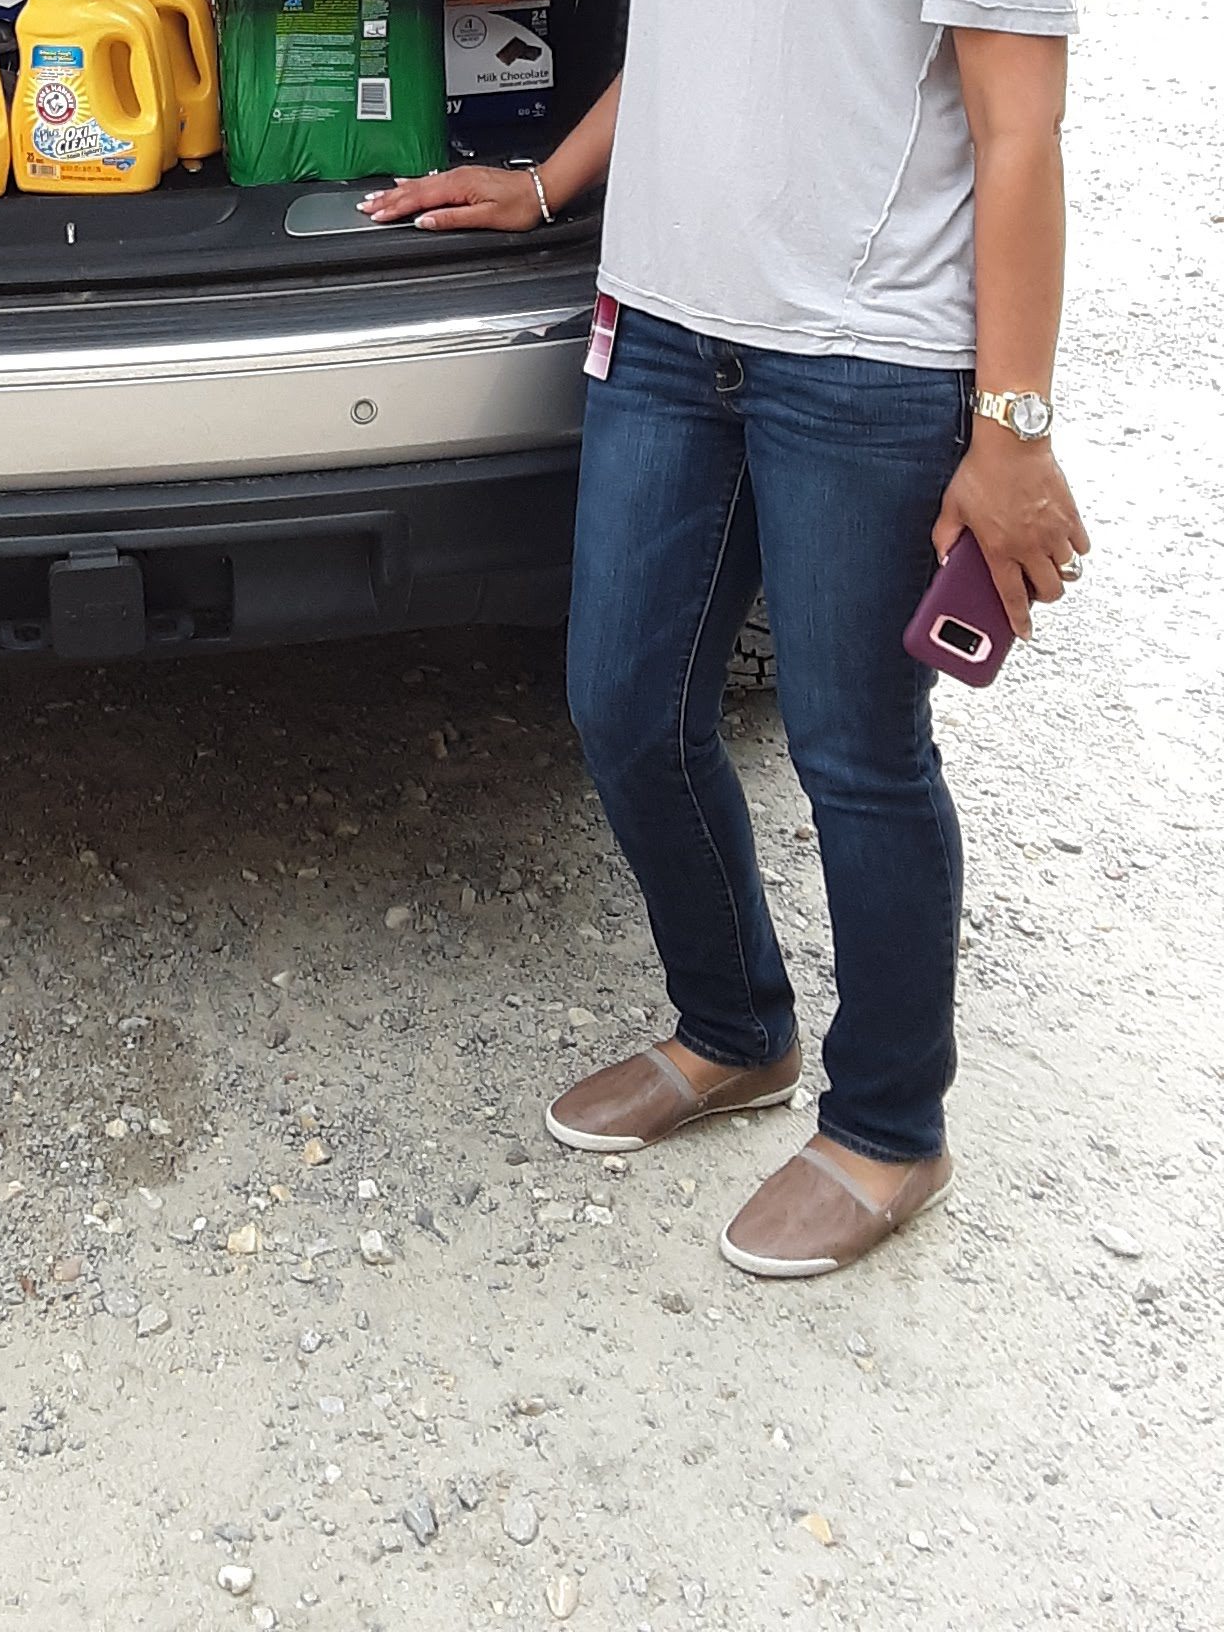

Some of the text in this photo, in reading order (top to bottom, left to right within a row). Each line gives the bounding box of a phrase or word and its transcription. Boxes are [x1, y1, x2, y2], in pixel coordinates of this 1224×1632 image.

[531, 10, 547, 21] 24
[477, 72, 498, 84] Milk
[501, 69, 550, 81] Chocolate
[40, 128, 61, 143] Plus
[64, 125, 89, 141] OXI
[56, 134, 98, 156] CLEAN
